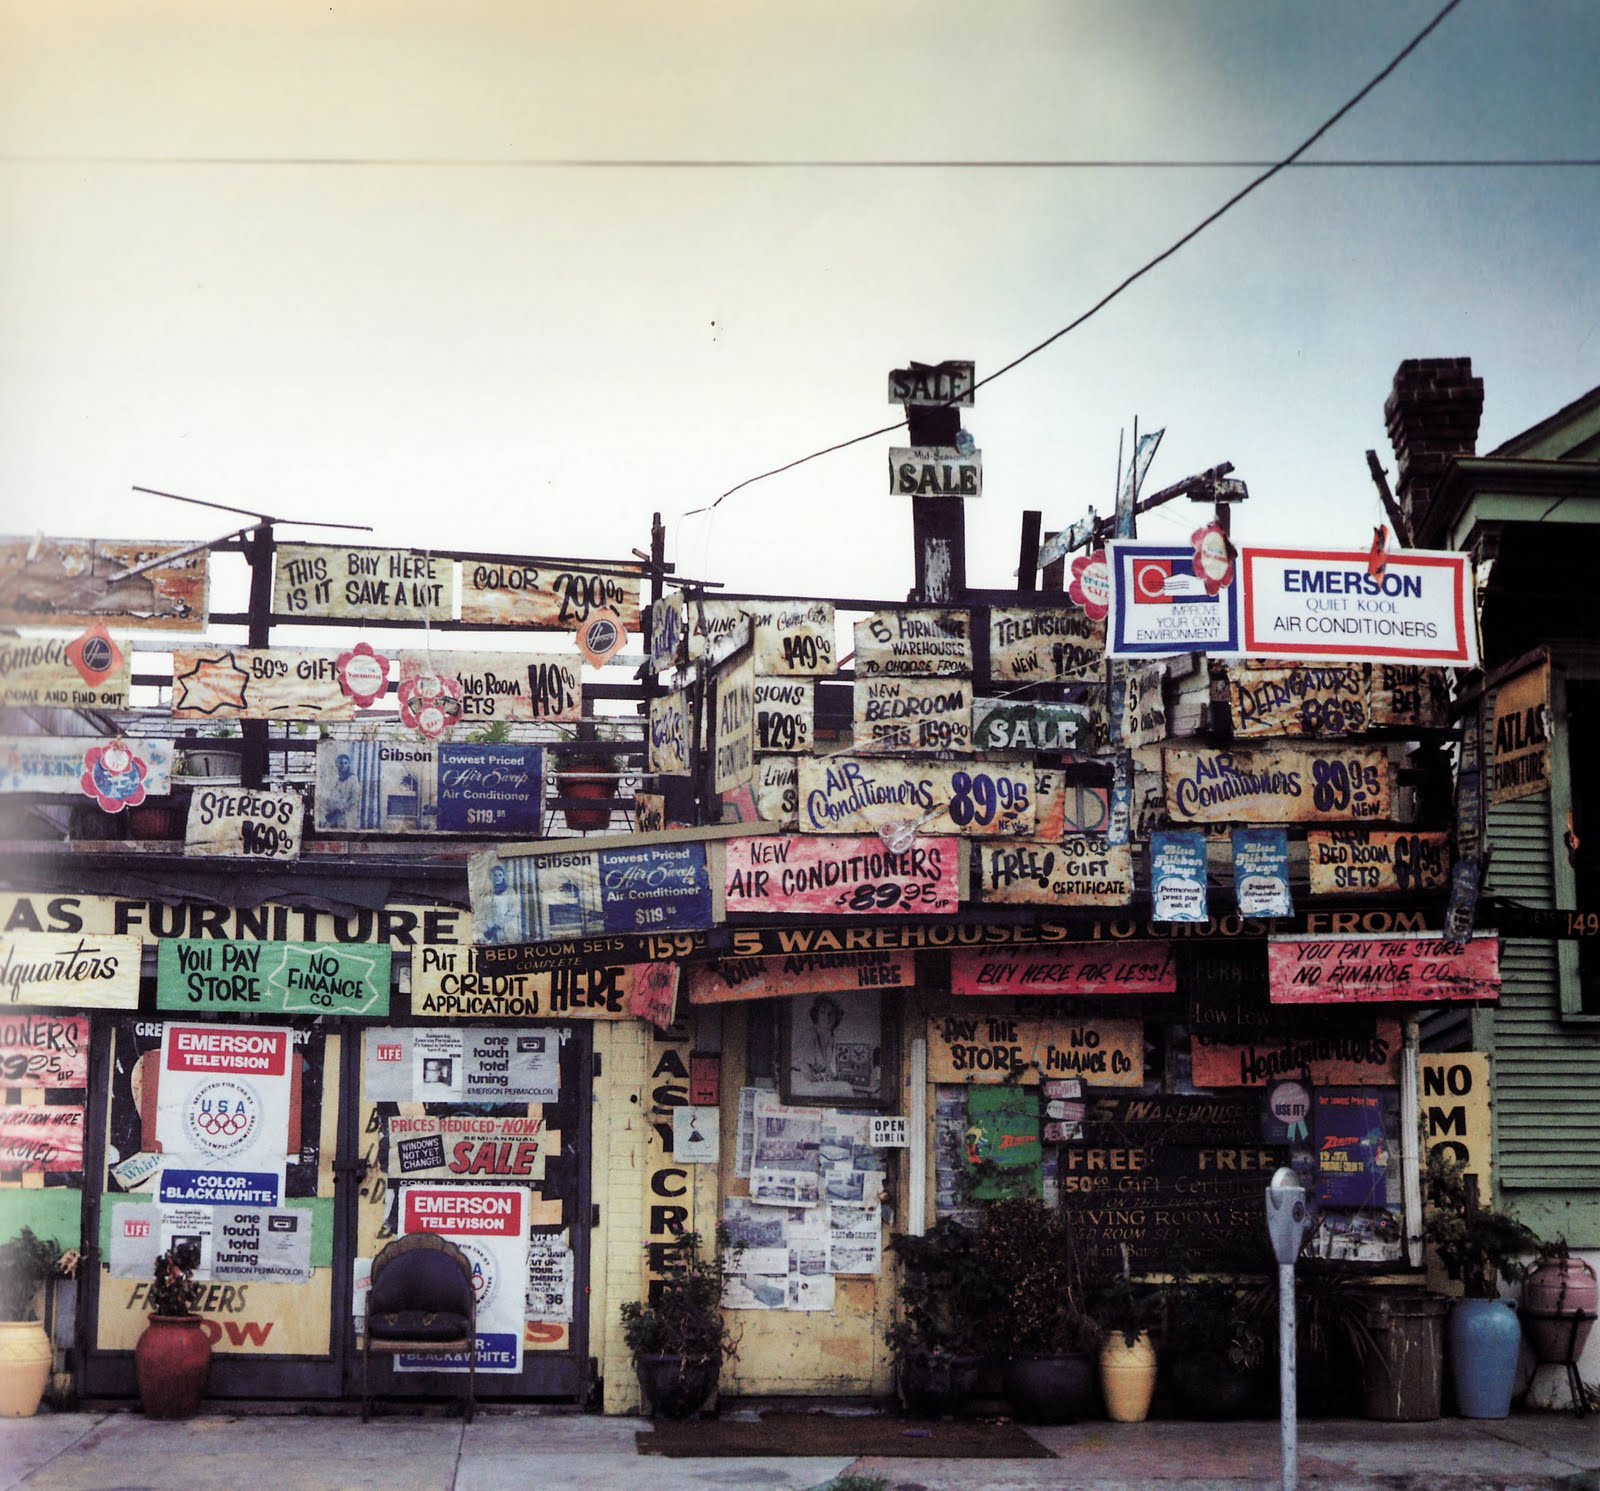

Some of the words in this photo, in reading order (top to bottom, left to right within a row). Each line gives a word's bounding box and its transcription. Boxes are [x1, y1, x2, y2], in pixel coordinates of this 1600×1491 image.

[899, 463, 977, 495] SALE
[282, 557, 328, 587] THIS
[347, 553, 380, 578] BUY
[390, 555, 437, 579] HERE
[473, 565, 540, 590] COLOR
[1284, 569, 1422, 599] EMERSON
[286, 587, 307, 611] IS
[315, 579, 333, 605] IT
[345, 580, 389, 606] SAVE
[394, 581, 408, 606] A
[413, 583, 444, 607] LOT
[1172, 605, 1219, 616] IMPROVE
[1306, 597, 1348, 613] QUIET
[1357, 600, 1399, 614] KOOL
[869, 619, 893, 644] 5
[994, 615, 1092, 647] TELEVISIONS
[1156, 617, 1188, 628] YOUR
[1193, 616, 1221, 628] OWN
[1273, 616, 1301, 632] AIR
[1306, 617, 1438, 638] CONDITIONERS
[1136, 628, 1220, 641] ENVIRONMENT
[890, 642, 966, 657] WAREHOUSES
[296, 658, 337, 680] GIFT
[865, 661, 880, 674] TO
[885, 659, 933, 674] CHOOSE
[1011, 648, 1040, 676] NEW
[484, 671, 521, 696] ROOM
[868, 683, 900, 699] NEW
[44, 690, 68, 703] AND
[72, 690, 97, 704] FIND
[101, 691, 125, 706] OUT
[865, 690, 964, 723] BEDROOM
[872, 723, 911, 747] SETS
[987, 718, 1079, 750] SALE
[1494, 703, 1549, 756] ATLAS
[379, 747, 432, 763] Gibson
[442, 755, 486, 766] Lowest
[488, 755, 525, 766] Priced
[1195, 752, 1238, 785] AIR
[824, 762, 864, 798] AIR
[442, 790, 460, 800] Air
[463, 789, 530, 801] Conditioner
[1176, 770, 1302, 818] Conditioners
[200, 791, 294, 825] STEREO'S
[807, 779, 942, 831] Conditioners
[1351, 801, 1381, 818] NEW
[535, 854, 592, 870] Gibson
[602, 852, 649, 866] Lowest
[652, 849, 690, 861] Priced
[750, 840, 791, 865] NEW
[1319, 844, 1348, 865] BED
[1352, 845, 1392, 865] ROOM
[728, 869, 769, 899] AIR
[782, 847, 942, 897] CONDITIONERS
[991, 847, 1055, 888] FREE!
[1066, 860, 1109, 877] GIFT
[1334, 866, 1381, 888] SETS
[606, 891, 625, 902] Air
[628, 886, 701, 901] Conditioner
[1052, 878, 1127, 897] CERTIFICATE
[115, 900, 460, 945] FURNITURE
[733, 931, 764, 956] 5
[778, 921, 1068, 953] WAREHOUSES
[1307, 911, 1427, 934] FROM
[177, 944, 212, 974] YOU
[222, 944, 261, 973] PAY
[422, 947, 458, 973] PUT
[485, 946, 517, 962] BED
[525, 942, 576, 959] ROOM
[583, 938, 625, 954] SETS
[1297, 943, 1333, 962] YOU
[1341, 942, 1373, 960] PAY
[1379, 941, 1410, 957] THE
[1412, 940, 1466, 958] STORE
[308, 954, 340, 977] NO
[516, 956, 583, 971] COMPLETE
[976, 963, 1019, 984] BUY
[1020, 963, 1073, 984] HERE
[1075, 963, 1114, 983] FOR
[1114, 958, 1171, 983] LESS!
[1292, 967, 1322, 985] NO
[1327, 962, 1413, 984] FINANCE
[288, 968, 364, 999] FINANCE
[440, 973, 529, 998] CREDIT
[858, 965, 901, 987] HERE
[187, 972, 261, 1002] STORE
[422, 991, 539, 1015] APPLICATION
[550, 967, 625, 1012] HERE
[484, 1036, 509, 1046] one
[942, 1019, 978, 1044] PAY
[985, 1019, 1018, 1043] THE
[1071, 1028, 1100, 1049] NO
[177, 1034, 278, 1054] EMERSON
[377, 1048, 402, 1061] LIFE
[473, 1047, 509, 1059] touch
[184, 1054, 270, 1069] TELEVISION
[479, 1060, 509, 1072] total
[951, 1044, 1025, 1071] STORE
[1046, 1046, 1107, 1074] FINANCE
[468, 1072, 509, 1087] tuning
[1423, 1064, 1473, 1097] NO
[467, 1087, 503, 1096] EMERSON
[504, 1087, 554, 1096] PERMACOLOR
[53, 1112, 82, 1126] HERE
[1275, 1103, 1291, 1116] USE
[391, 1119, 435, 1133] PRICES
[874, 1120, 905, 1132] OPEN
[401, 1138, 440, 1151] WINDOWS
[874, 1133, 895, 1143] COME
[896, 1133, 906, 1143] IN
[402, 1150, 421, 1161] NOT
[422, 1147, 440, 1158] YET
[403, 1157, 442, 1171] CHANGED
[448, 1142, 539, 1175] SALE
[1068, 1149, 1145, 1171] FREE
[1199, 1149, 1278, 1171] FREE
[197, 1176, 247, 1189] COLOR
[166, 1187, 272, 1202] BLACK&WHITE
[414, 1196, 512, 1215] EMERSON
[234, 1214, 261, 1225] one
[420, 1216, 505, 1230] TELEVISION
[124, 1225, 150, 1237] LIFE
[222, 1225, 260, 1237] touch
[228, 1238, 260, 1251] total
[216, 1252, 259, 1266] tuning
[215, 1266, 252, 1275] EMERSON
[253, 1266, 304, 1276] PERMACOLOR
